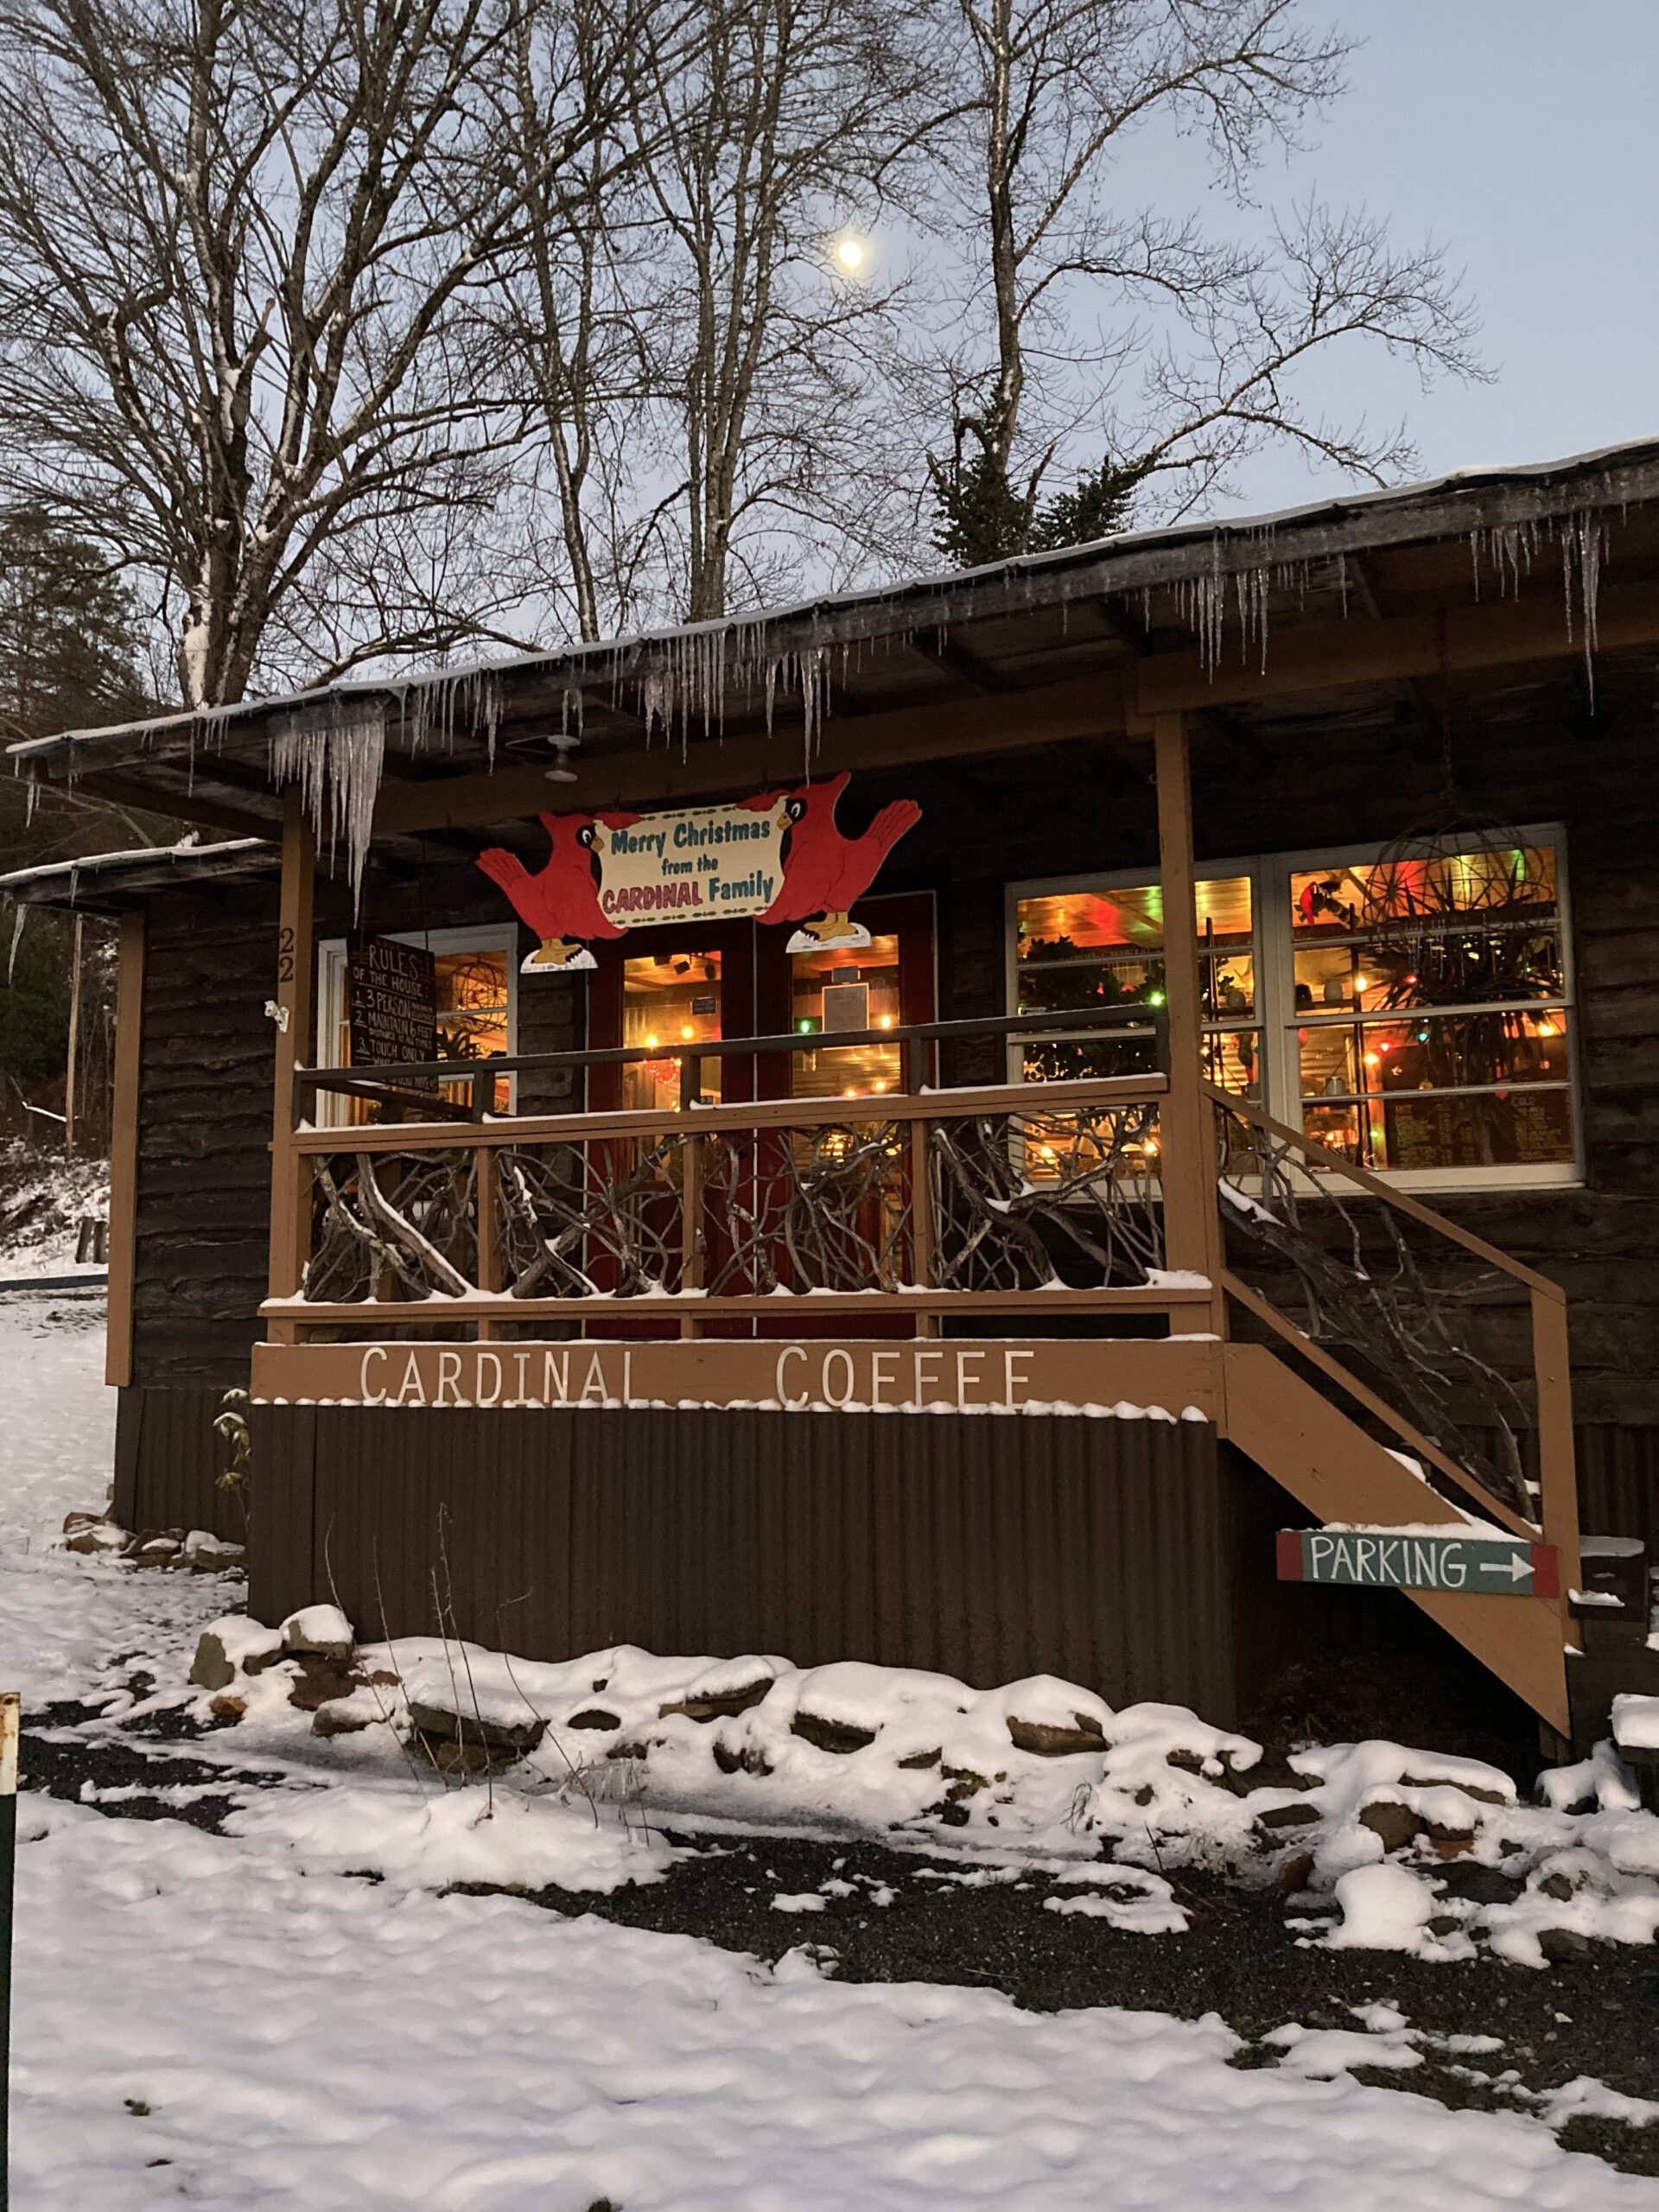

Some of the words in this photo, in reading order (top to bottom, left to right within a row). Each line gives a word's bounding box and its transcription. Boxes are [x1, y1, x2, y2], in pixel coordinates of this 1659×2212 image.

[611, 830, 666, 858] Merry
[673, 820, 771, 848] Christmas
[662, 858, 692, 875] from
[697, 854, 718, 872] the
[602, 881, 703, 914] CARDINAL
[709, 870, 774, 903] Family
[353, 966, 365, 981] OF
[369, 970, 388, 987] THE
[369, 944, 418, 981] RULES
[366, 988, 376, 1008] 3
[377, 992, 410, 1019] PERSON
[368, 1011, 408, 1035] MAINTAIN
[410, 1020, 416, 1037] 6
[417, 1025, 433, 1039] FEET
[368, 1027, 396, 1041] DISTANCE
[405, 1036, 415, 1046] ALL
[416, 1038, 432, 1050] TIMES
[369, 1039, 397, 1058] TOUCH
[402, 1046, 425, 1064] ONLY
[360, 1346, 650, 1406] CARDINAL
[776, 1346, 1034, 1409] COFFEE
[1311, 1536, 1467, 1587] PARKING
